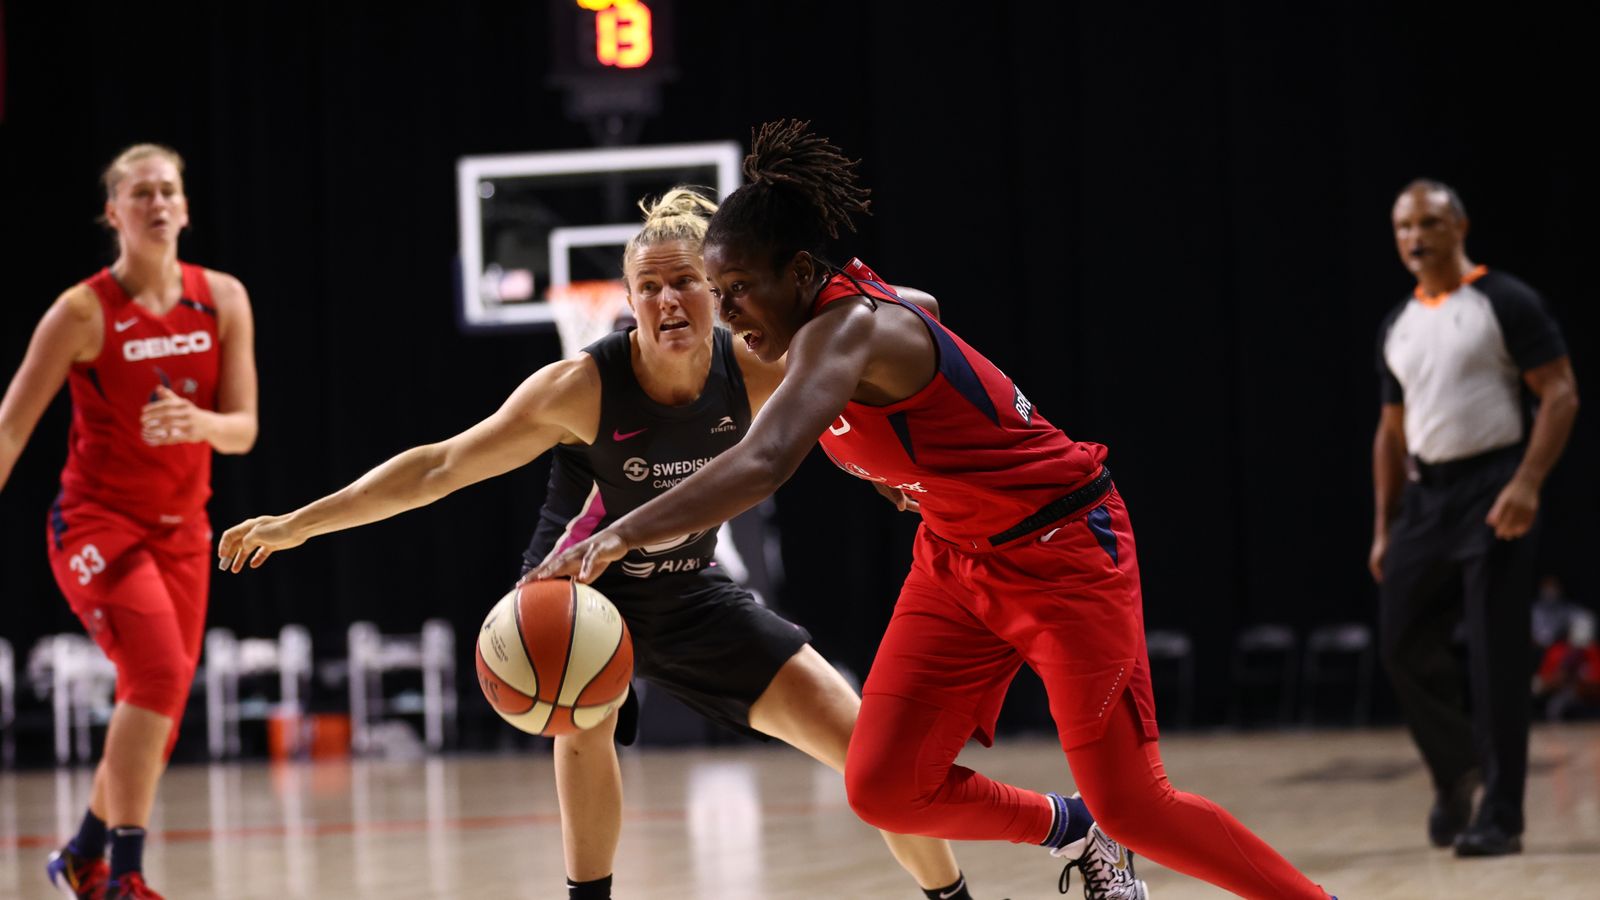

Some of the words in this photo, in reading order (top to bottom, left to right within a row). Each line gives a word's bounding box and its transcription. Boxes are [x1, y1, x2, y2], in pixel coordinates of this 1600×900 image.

[596, 0, 652, 68] 13
[123, 330, 212, 361] GEICO
[652, 457, 714, 476] SWEDIS
[653, 477, 687, 488] CANC
[70, 544, 105, 585] 33
